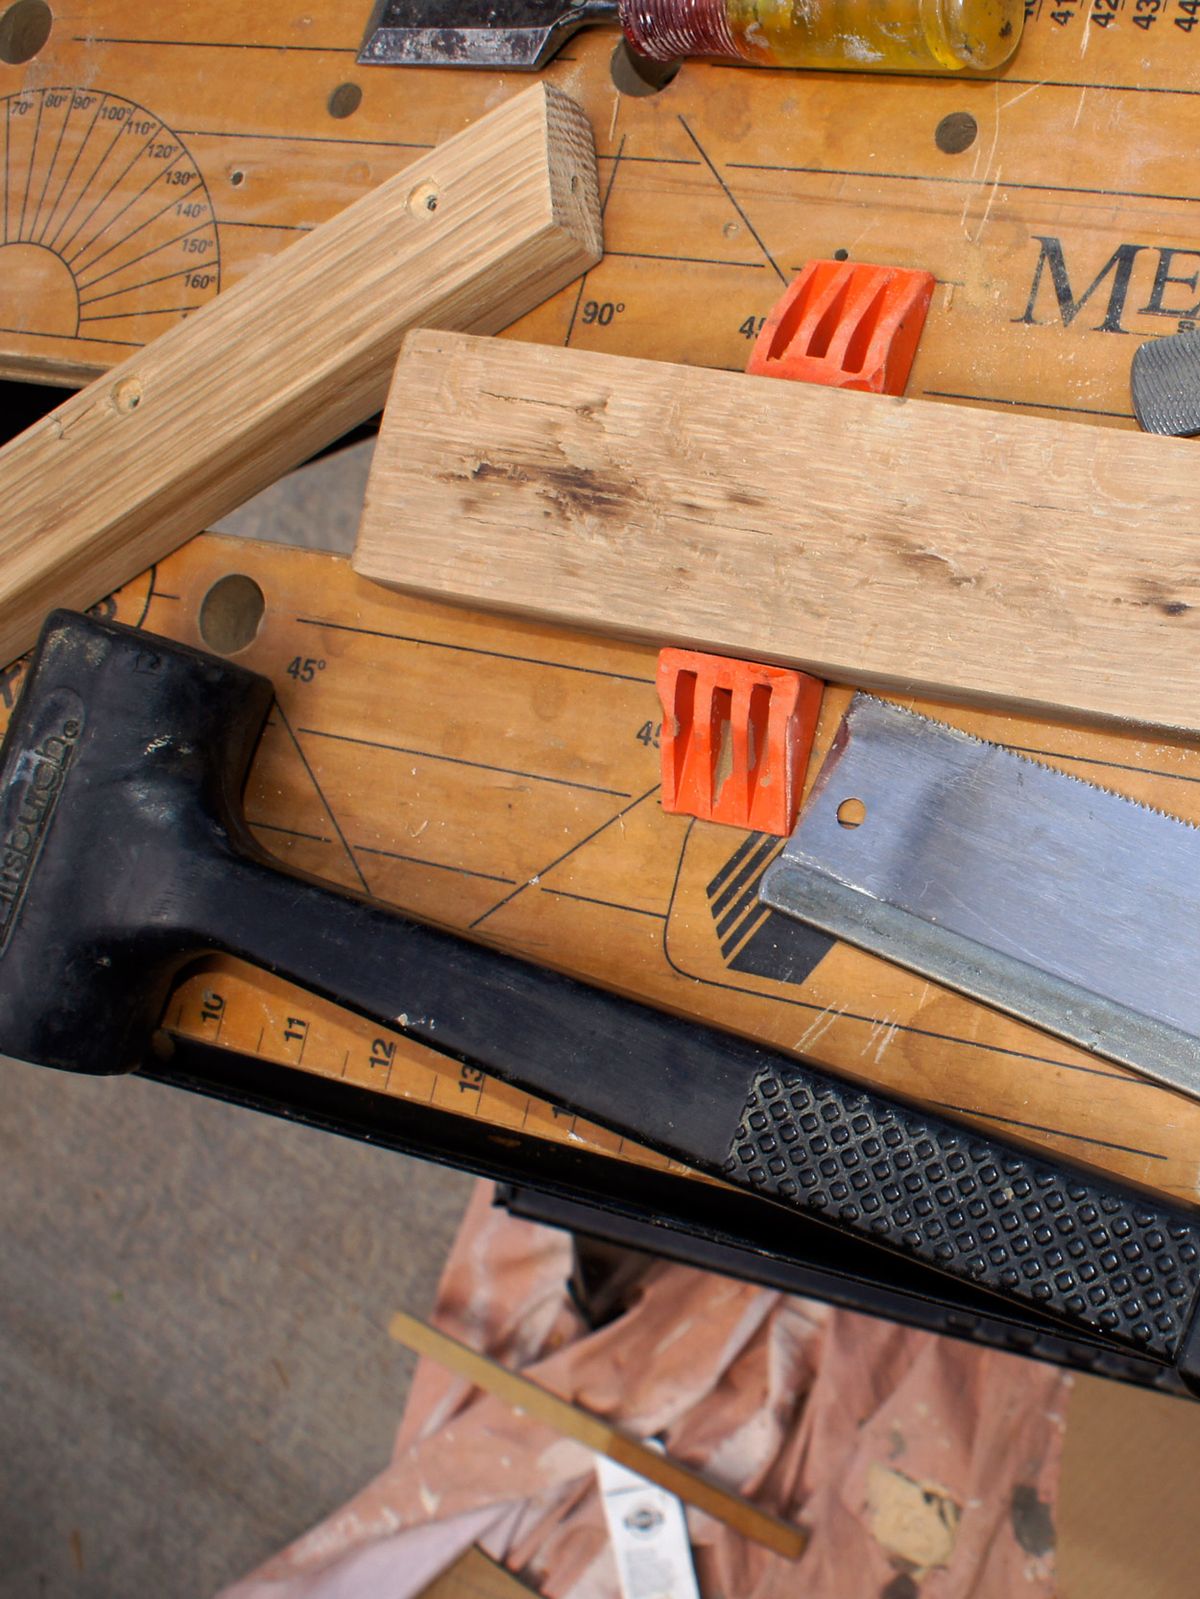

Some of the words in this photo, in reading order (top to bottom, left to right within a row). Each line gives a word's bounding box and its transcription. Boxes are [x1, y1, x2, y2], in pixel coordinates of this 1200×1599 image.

[1132, 0, 1161, 30] 43
[200, 992, 225, 1025] 10
[284, 1016, 307, 1043] 11
[368, 1038, 396, 1069] 12
[458, 1063, 486, 1094] 13
